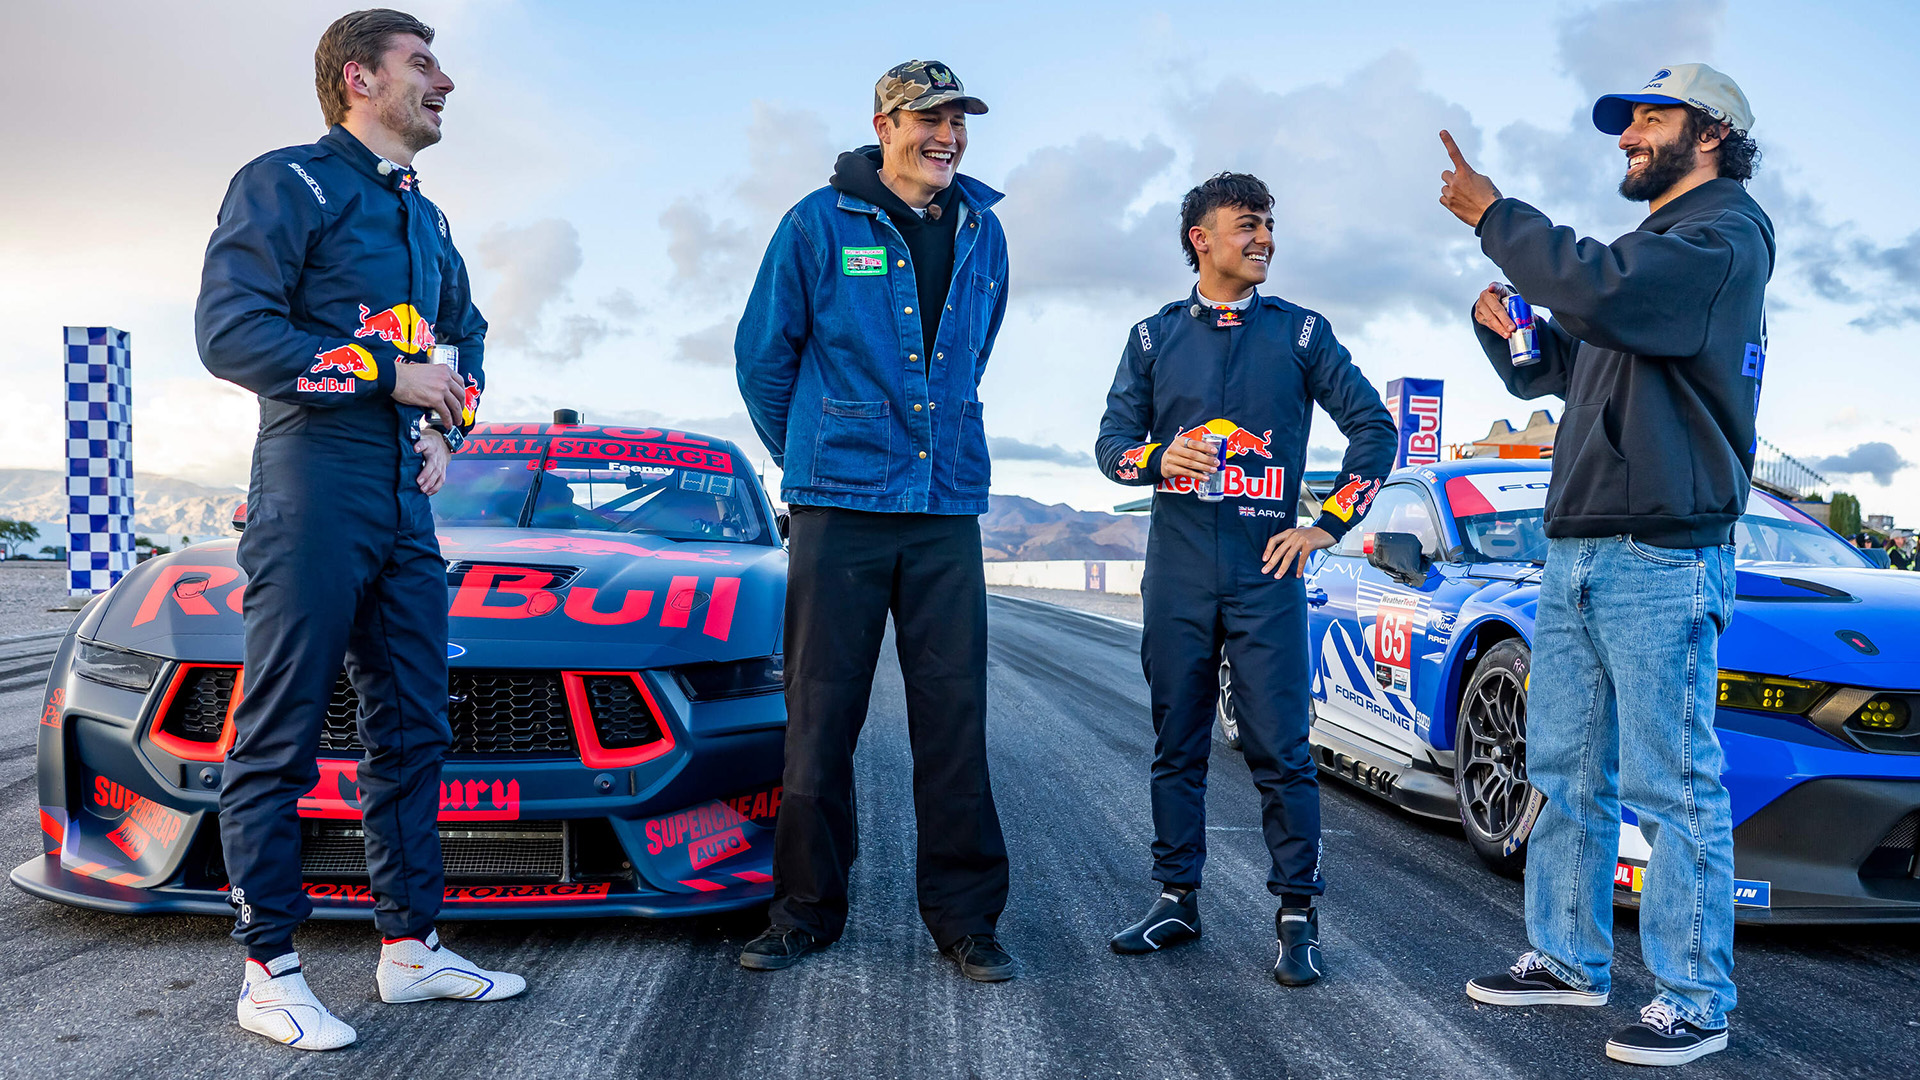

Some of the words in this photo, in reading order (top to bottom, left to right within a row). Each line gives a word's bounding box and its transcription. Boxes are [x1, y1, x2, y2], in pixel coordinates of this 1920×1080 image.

[288, 163, 326, 204] sparco
[1298, 315, 1316, 348] sparco
[297, 377, 327, 392] Red
[327, 377, 356, 393] Bull
[468, 423, 709, 446] MPOL
[1408, 395, 1440, 454] Bull
[526, 459, 557, 470] 88
[556, 440, 725, 469] STORAGE
[609, 462, 675, 476] Feeney
[1224, 464, 1285, 501] Bull
[1356, 493, 1372, 516] Red
[1367, 477, 1381, 502] Bull
[1498, 482, 1549, 491] FO
[448, 564, 741, 642] Bull
[1382, 595, 1417, 607] WeatherTech
[1435, 614, 1456, 631] Ford
[1381, 613, 1407, 662] 65
[1335, 684, 1364, 707] FORD
[1366, 701, 1410, 731] RACING
[94, 775, 182, 849] SUPERCHEAP
[116, 826, 144, 852] AUTO
[697, 836, 741, 863] AUTO
[446, 884, 601, 900] TORAGE
